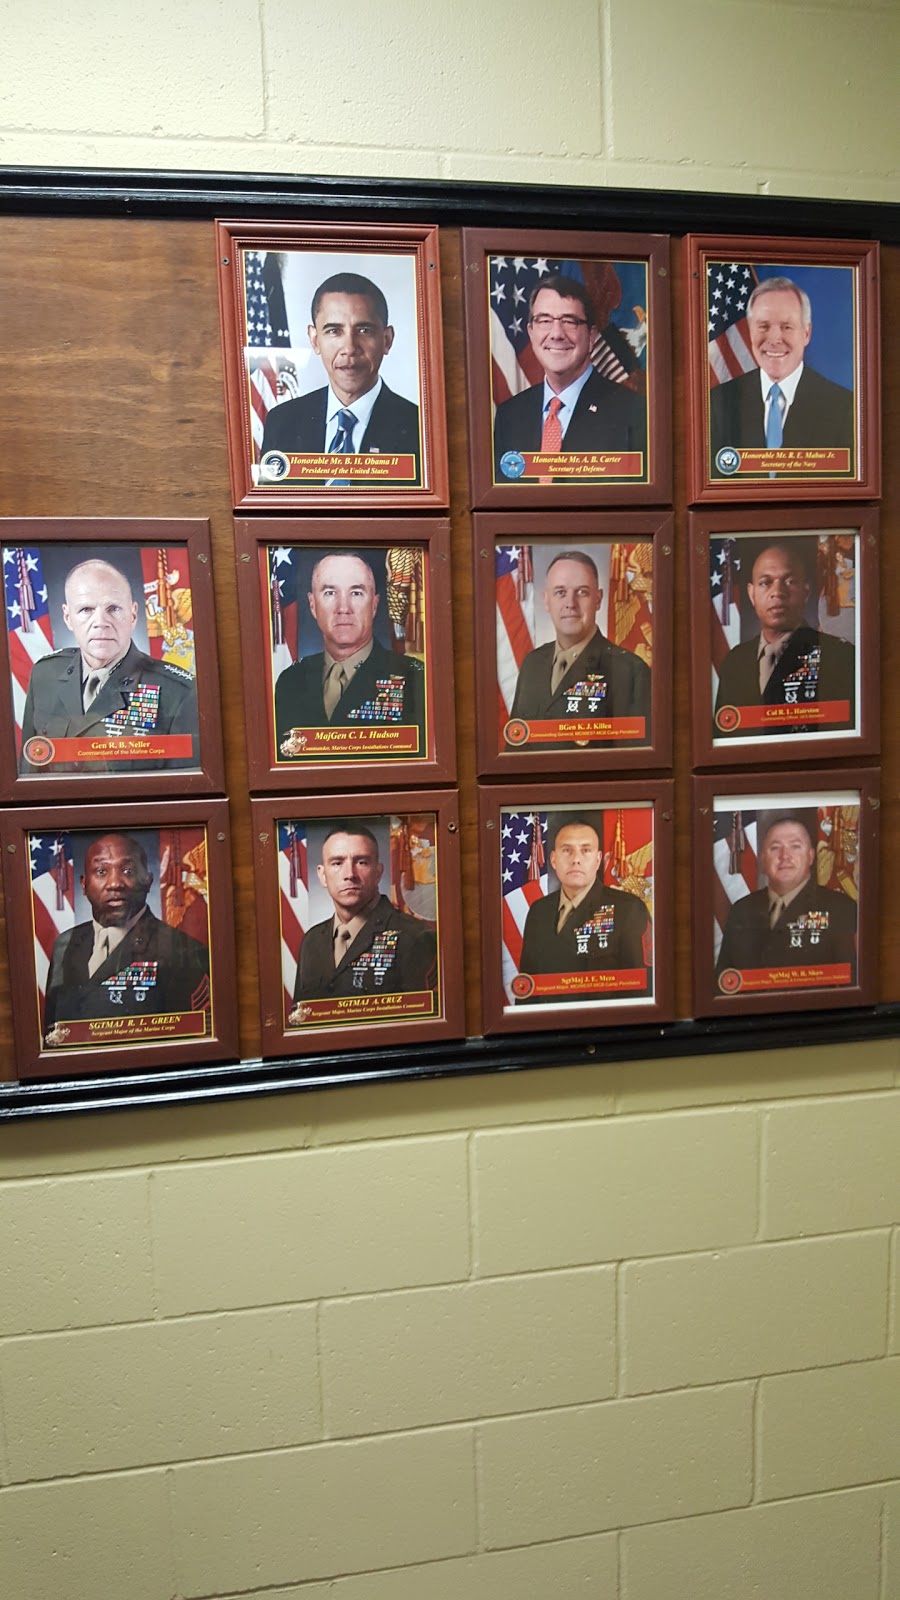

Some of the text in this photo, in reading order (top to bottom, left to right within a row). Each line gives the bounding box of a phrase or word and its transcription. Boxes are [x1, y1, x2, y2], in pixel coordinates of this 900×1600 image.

[315, 732, 346, 741] MajGen
[338, 999, 369, 1007] SGTMAJ
[89, 1020, 124, 1030] SGTMAJ
[151, 1016, 181, 1024] GREEN
